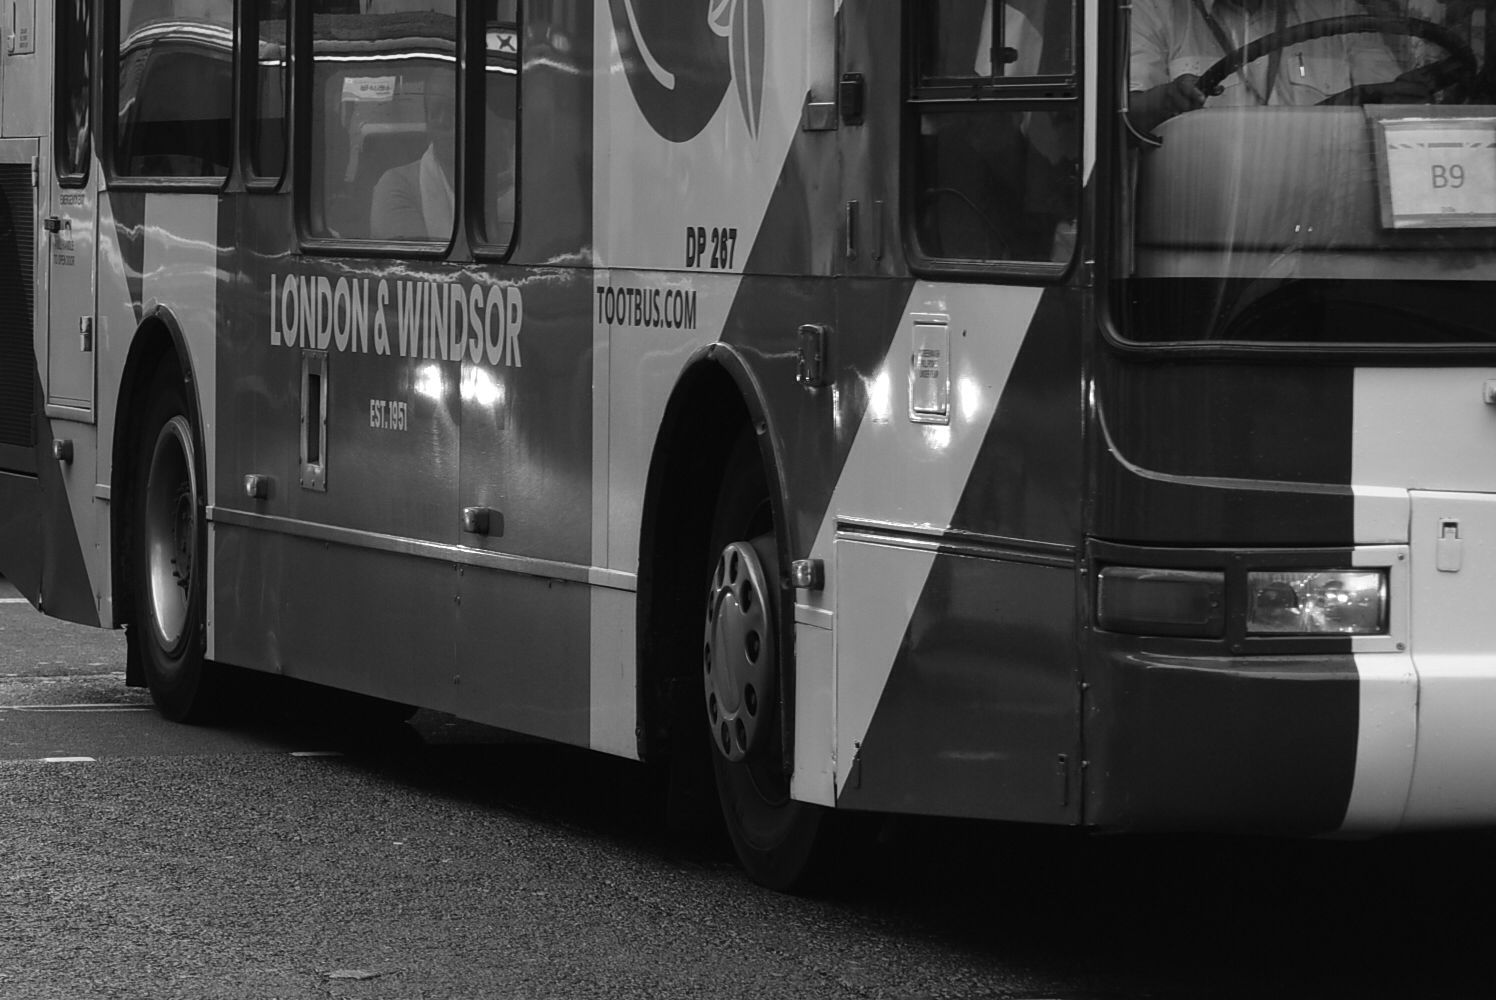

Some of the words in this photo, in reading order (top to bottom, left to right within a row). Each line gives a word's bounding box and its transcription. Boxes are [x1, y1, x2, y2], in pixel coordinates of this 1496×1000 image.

[1431, 164, 1465, 189] B9
[686, 226, 706, 268] DP
[270, 273, 369, 353] LONDON
[374, 278, 391, 355] &
[397, 280, 523, 367] WINDSOR
[597, 286, 697, 329] TOOTBUS.COM
